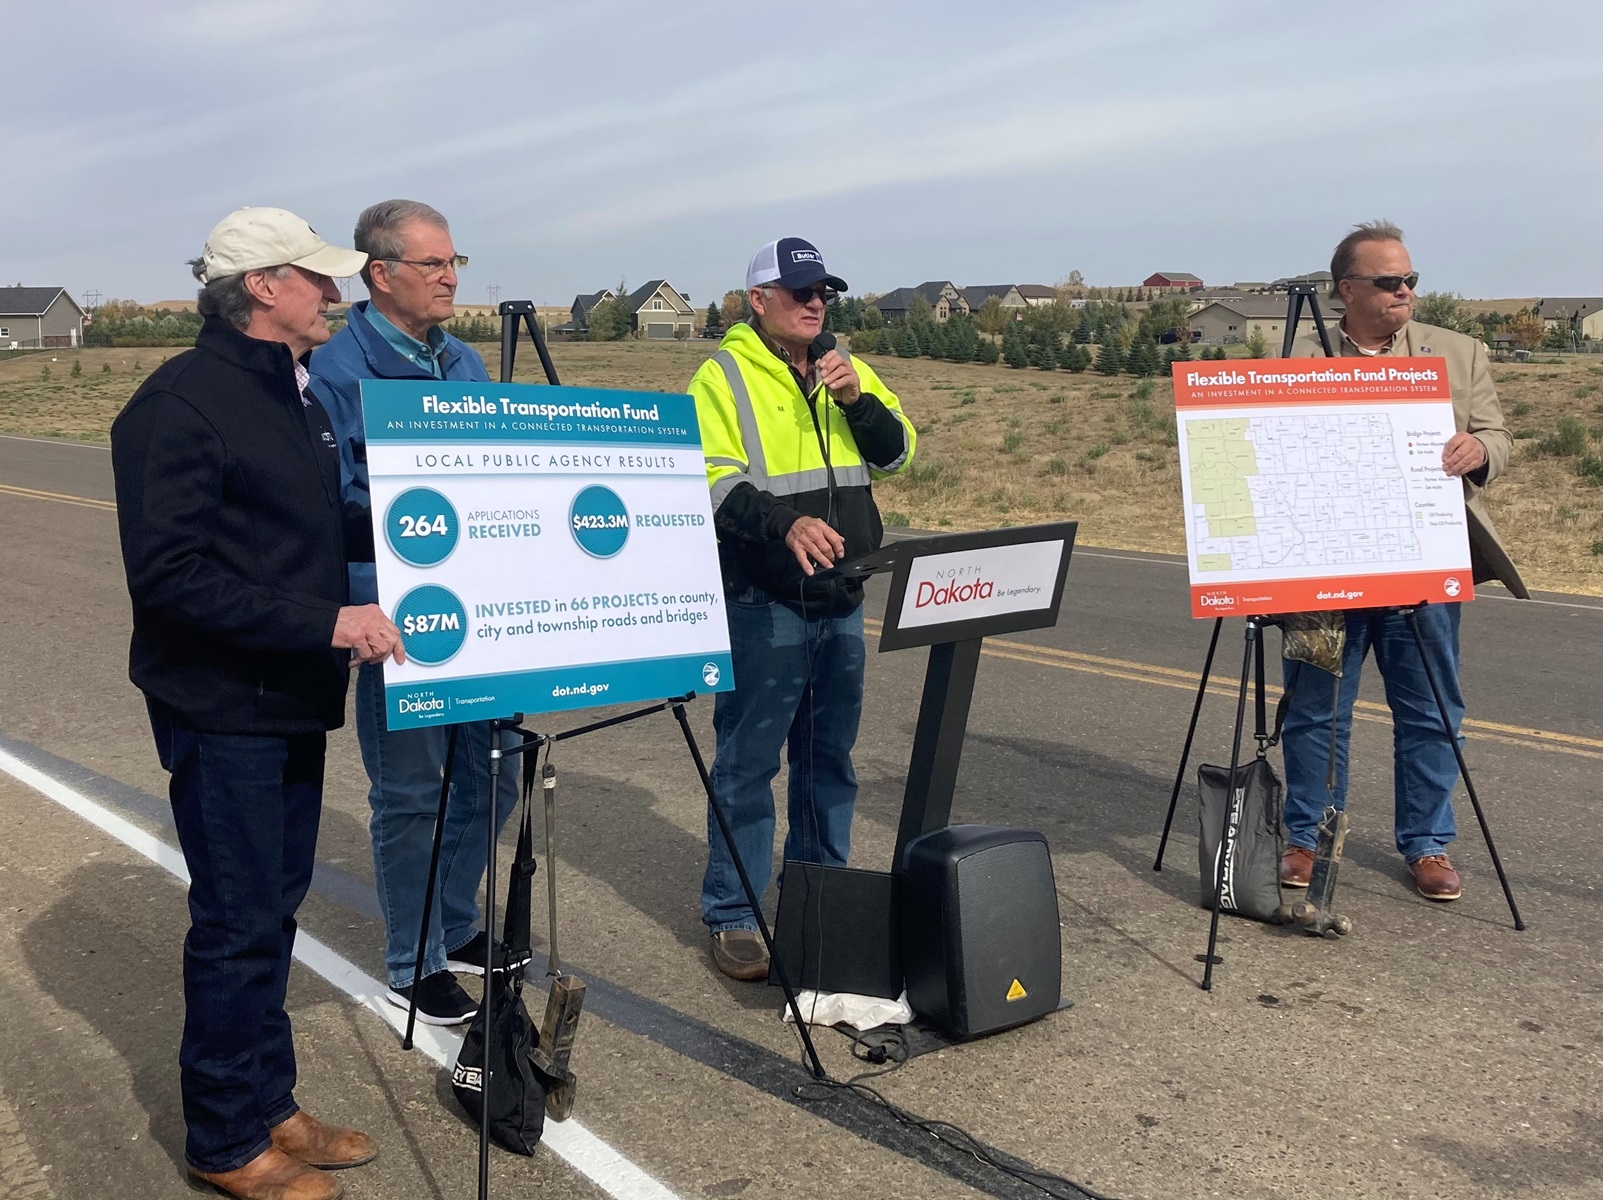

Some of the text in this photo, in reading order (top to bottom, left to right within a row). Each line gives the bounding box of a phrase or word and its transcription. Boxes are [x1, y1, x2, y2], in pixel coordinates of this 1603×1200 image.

[1186, 368, 1438, 386] Flexible Transportation Fund Projects
[422, 395, 659, 421] Flexible Transportation Fund
[387, 421, 687, 436] AN INVESTMENT IN A CONNECTED TRANSPORTATION SYSTEM
[416, 454, 675, 468] LOCAL PUBLIC AGENCY RESULTS
[467, 510, 540, 521] APPLICATIONS
[573, 514, 628, 530] $423.3M
[636, 514, 705, 528] REQUESTED
[399, 515, 448, 537] 264
[469, 524, 541, 539] RECEIVED
[936, 565, 981, 579] NORTH
[915, 578, 994, 608] Dakota
[1007, 585, 1041, 595] Legendary.
[1316, 590, 1363, 601] dot.nd.gov
[475, 591, 717, 618] INVESTED in 66 PROJECTS on county,
[1201, 595, 1234, 606] Dakota
[403, 613, 459, 636] $87M
[477, 609, 708, 641] city and township roads and bridges
[408, 691, 434, 699] NORTH
[552, 682, 609, 698] dot.nd.gov
[399, 698, 444, 713] Dakota
[455, 696, 495, 704] Transportation
